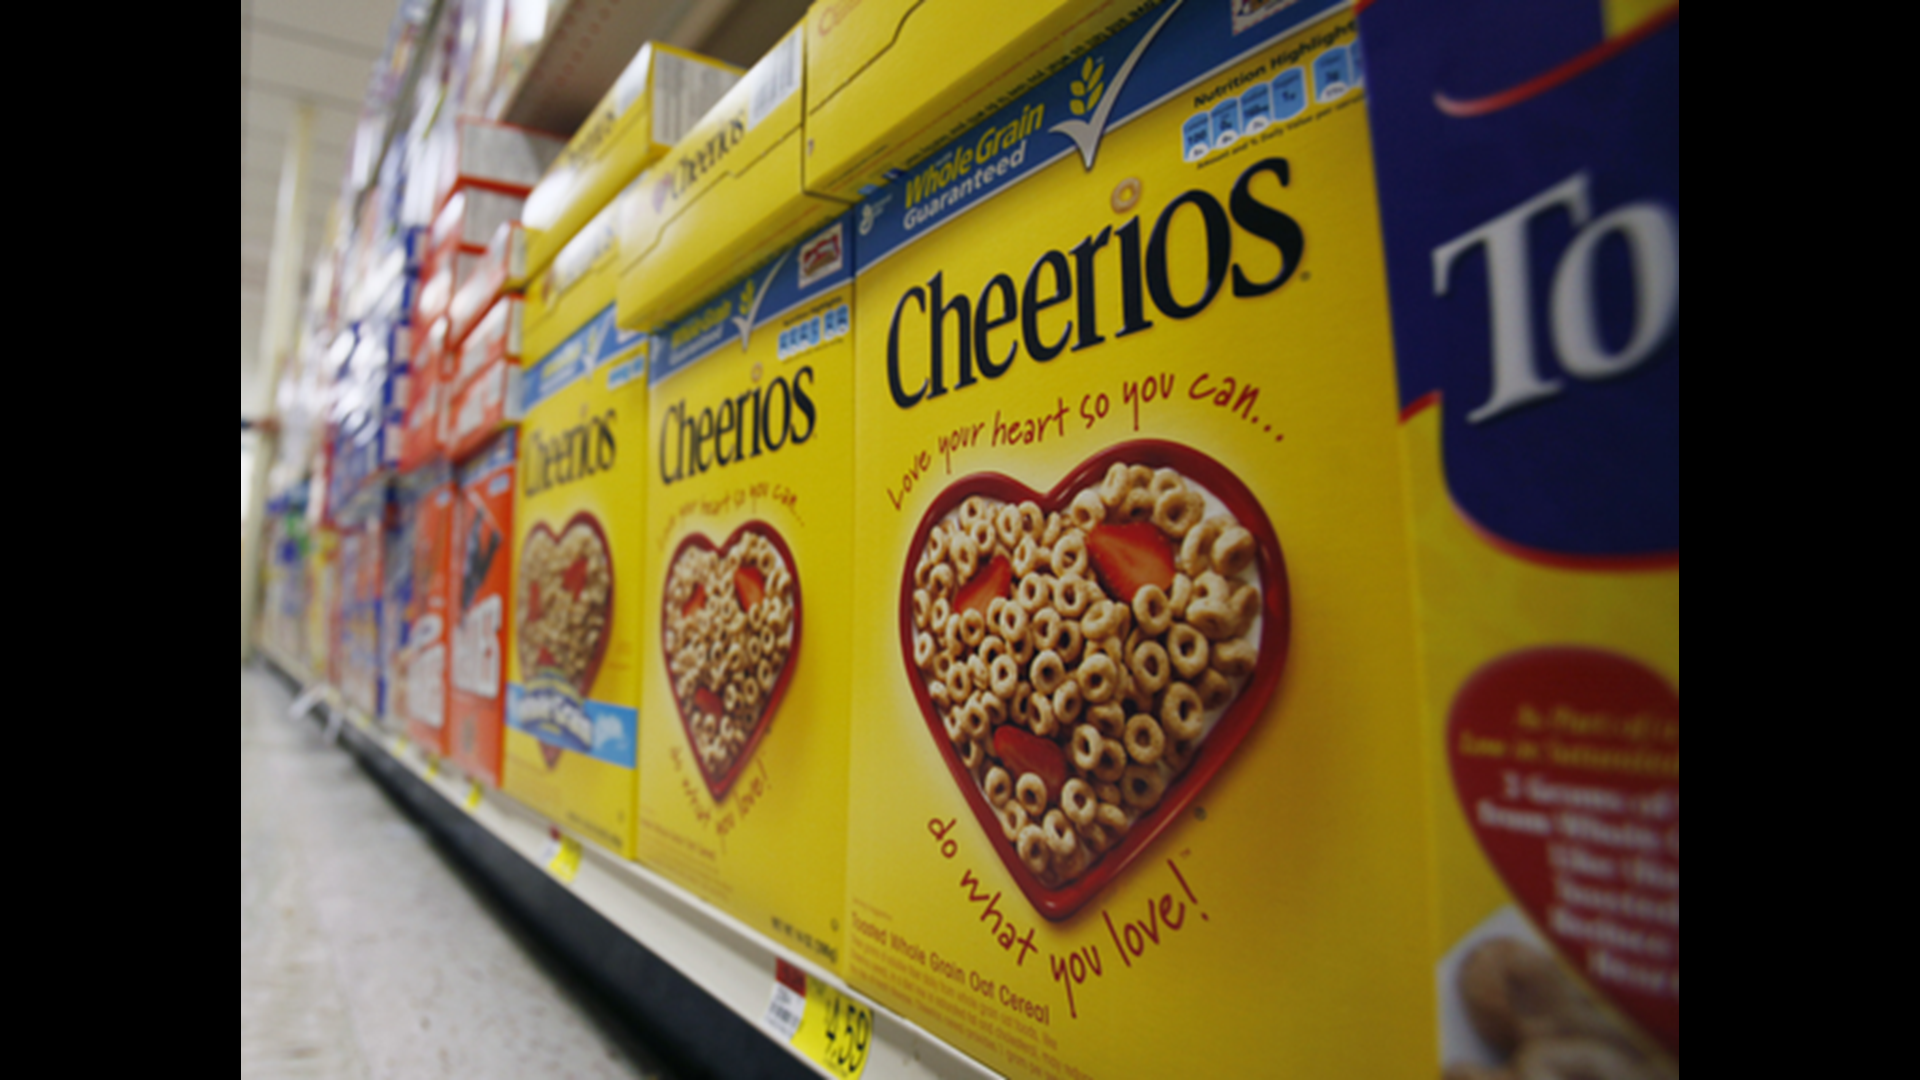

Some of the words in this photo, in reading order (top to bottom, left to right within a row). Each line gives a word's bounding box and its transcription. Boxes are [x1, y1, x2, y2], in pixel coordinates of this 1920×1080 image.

[1194, 64, 1267, 109] Nutrition
[904, 139, 1026, 230] Guaranteed
[905, 146, 973, 209] Whole
[975, 104, 1044, 165] Grain
[887, 157, 1305, 410] Cheerios
[1431, 170, 1679, 425] To
[660, 365, 817, 486] Cheerios
[887, 449, 932, 512] Love
[938, 420, 985, 475] your
[992, 397, 1069, 447] heart
[1080, 393, 1109, 429] so
[1123, 372, 1175, 432] you
[1188, 372, 1285, 443] can...
[852, 911, 887, 946] Toasted
[890, 931, 926, 966] Whole
[930, 951, 966, 986] Grain
[968, 970, 995, 999] Oat
[998, 984, 1050, 1027] Cereal
[927, 817, 958, 859] do
[959, 868, 1039, 967] what
[1050, 944, 1103, 1020] you
[1101, 858, 1209, 968] love!
[824, 996, 871, 1073] 4.59
